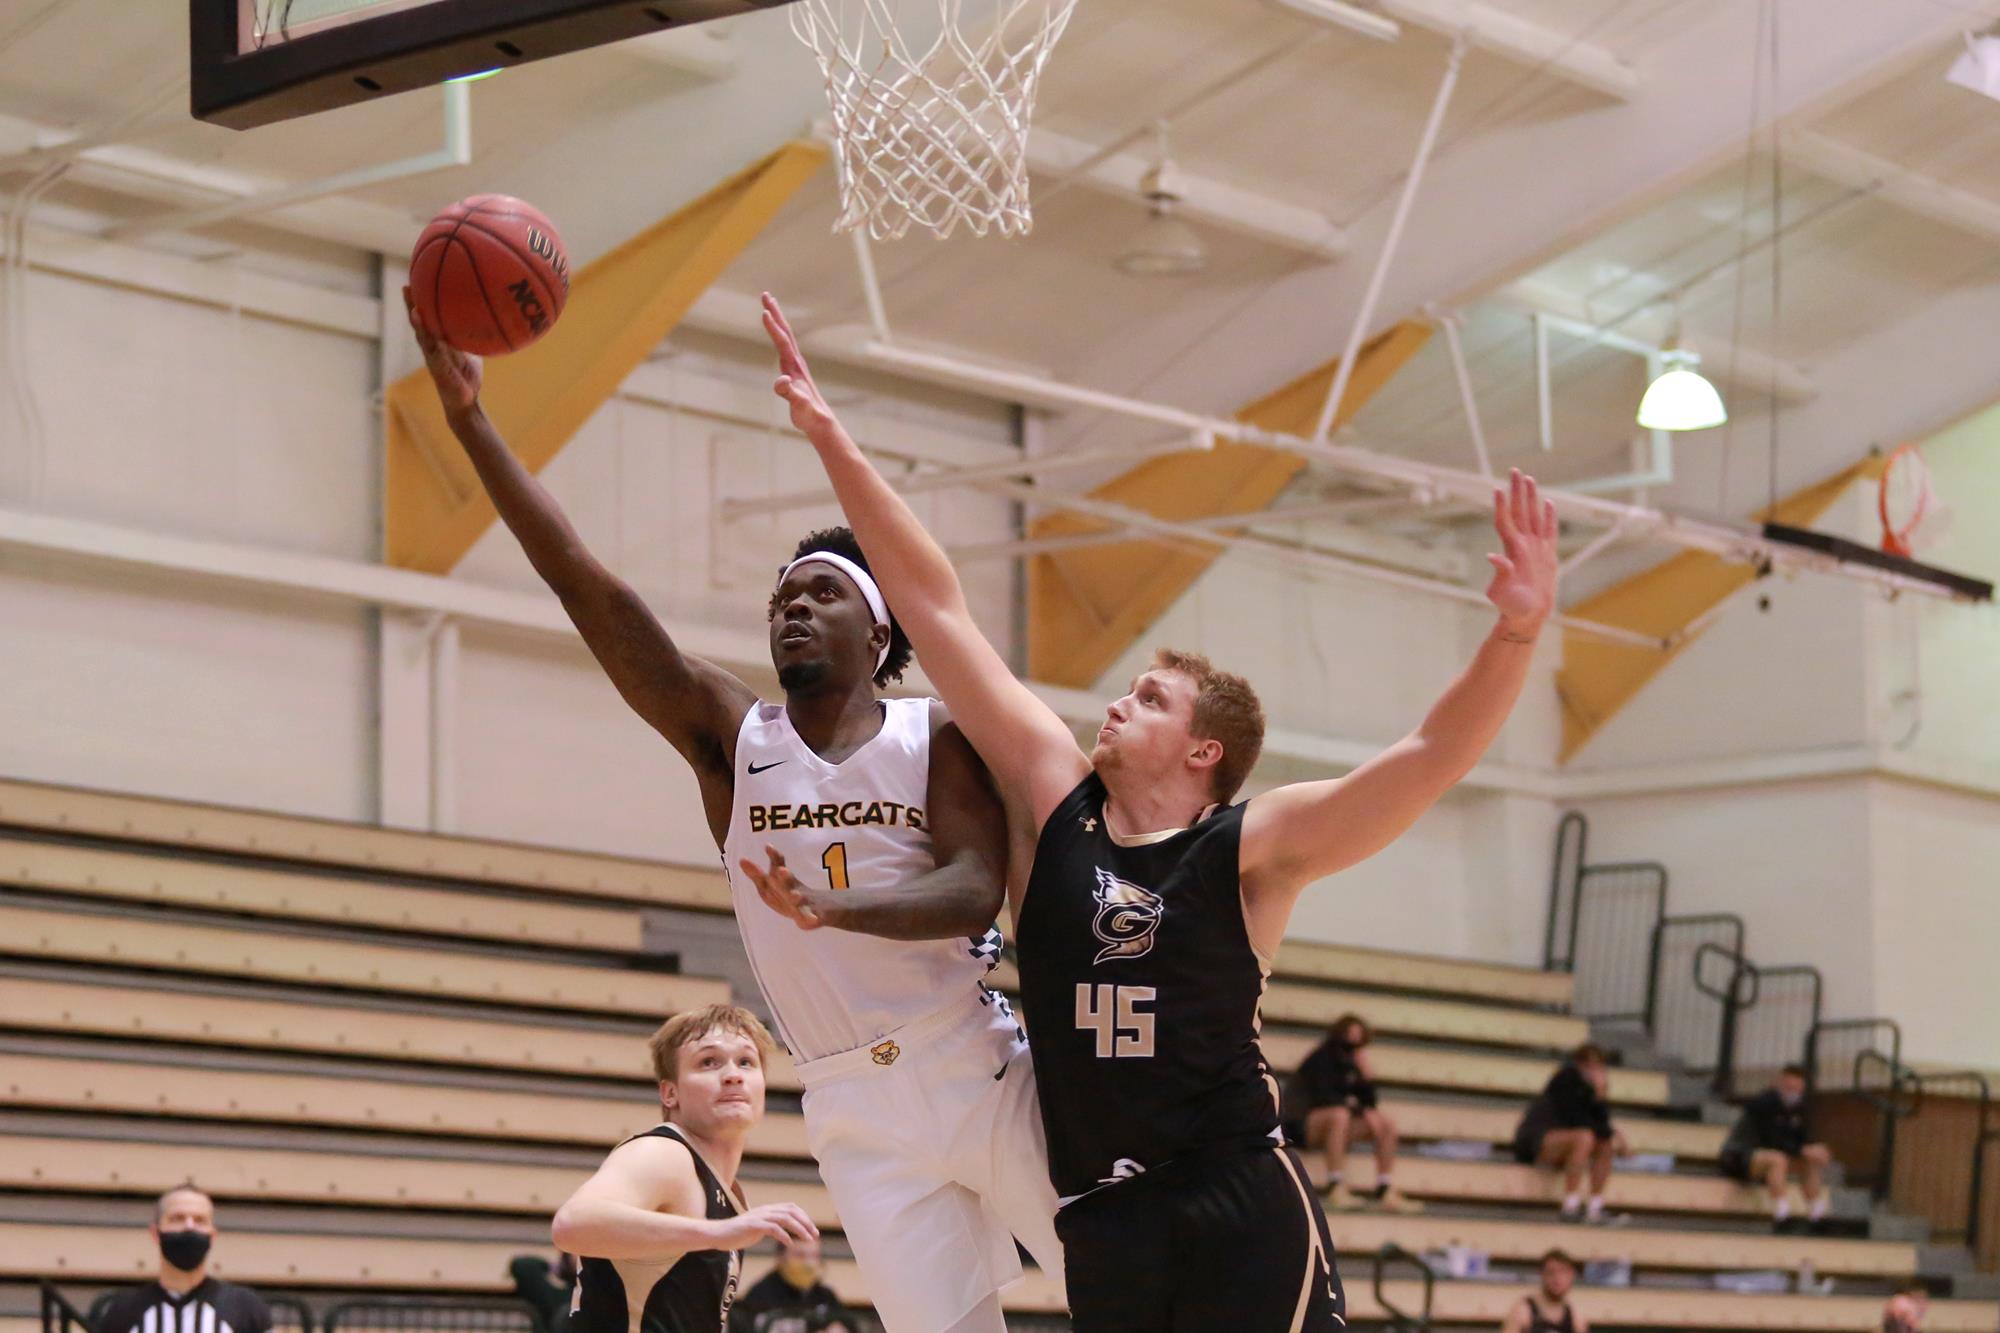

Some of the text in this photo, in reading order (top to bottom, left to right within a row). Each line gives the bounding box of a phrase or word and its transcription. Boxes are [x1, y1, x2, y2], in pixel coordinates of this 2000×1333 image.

[749, 801, 927, 833] BEARCATS
[821, 841, 850, 891] 1
[1074, 982, 1157, 1058] 45
